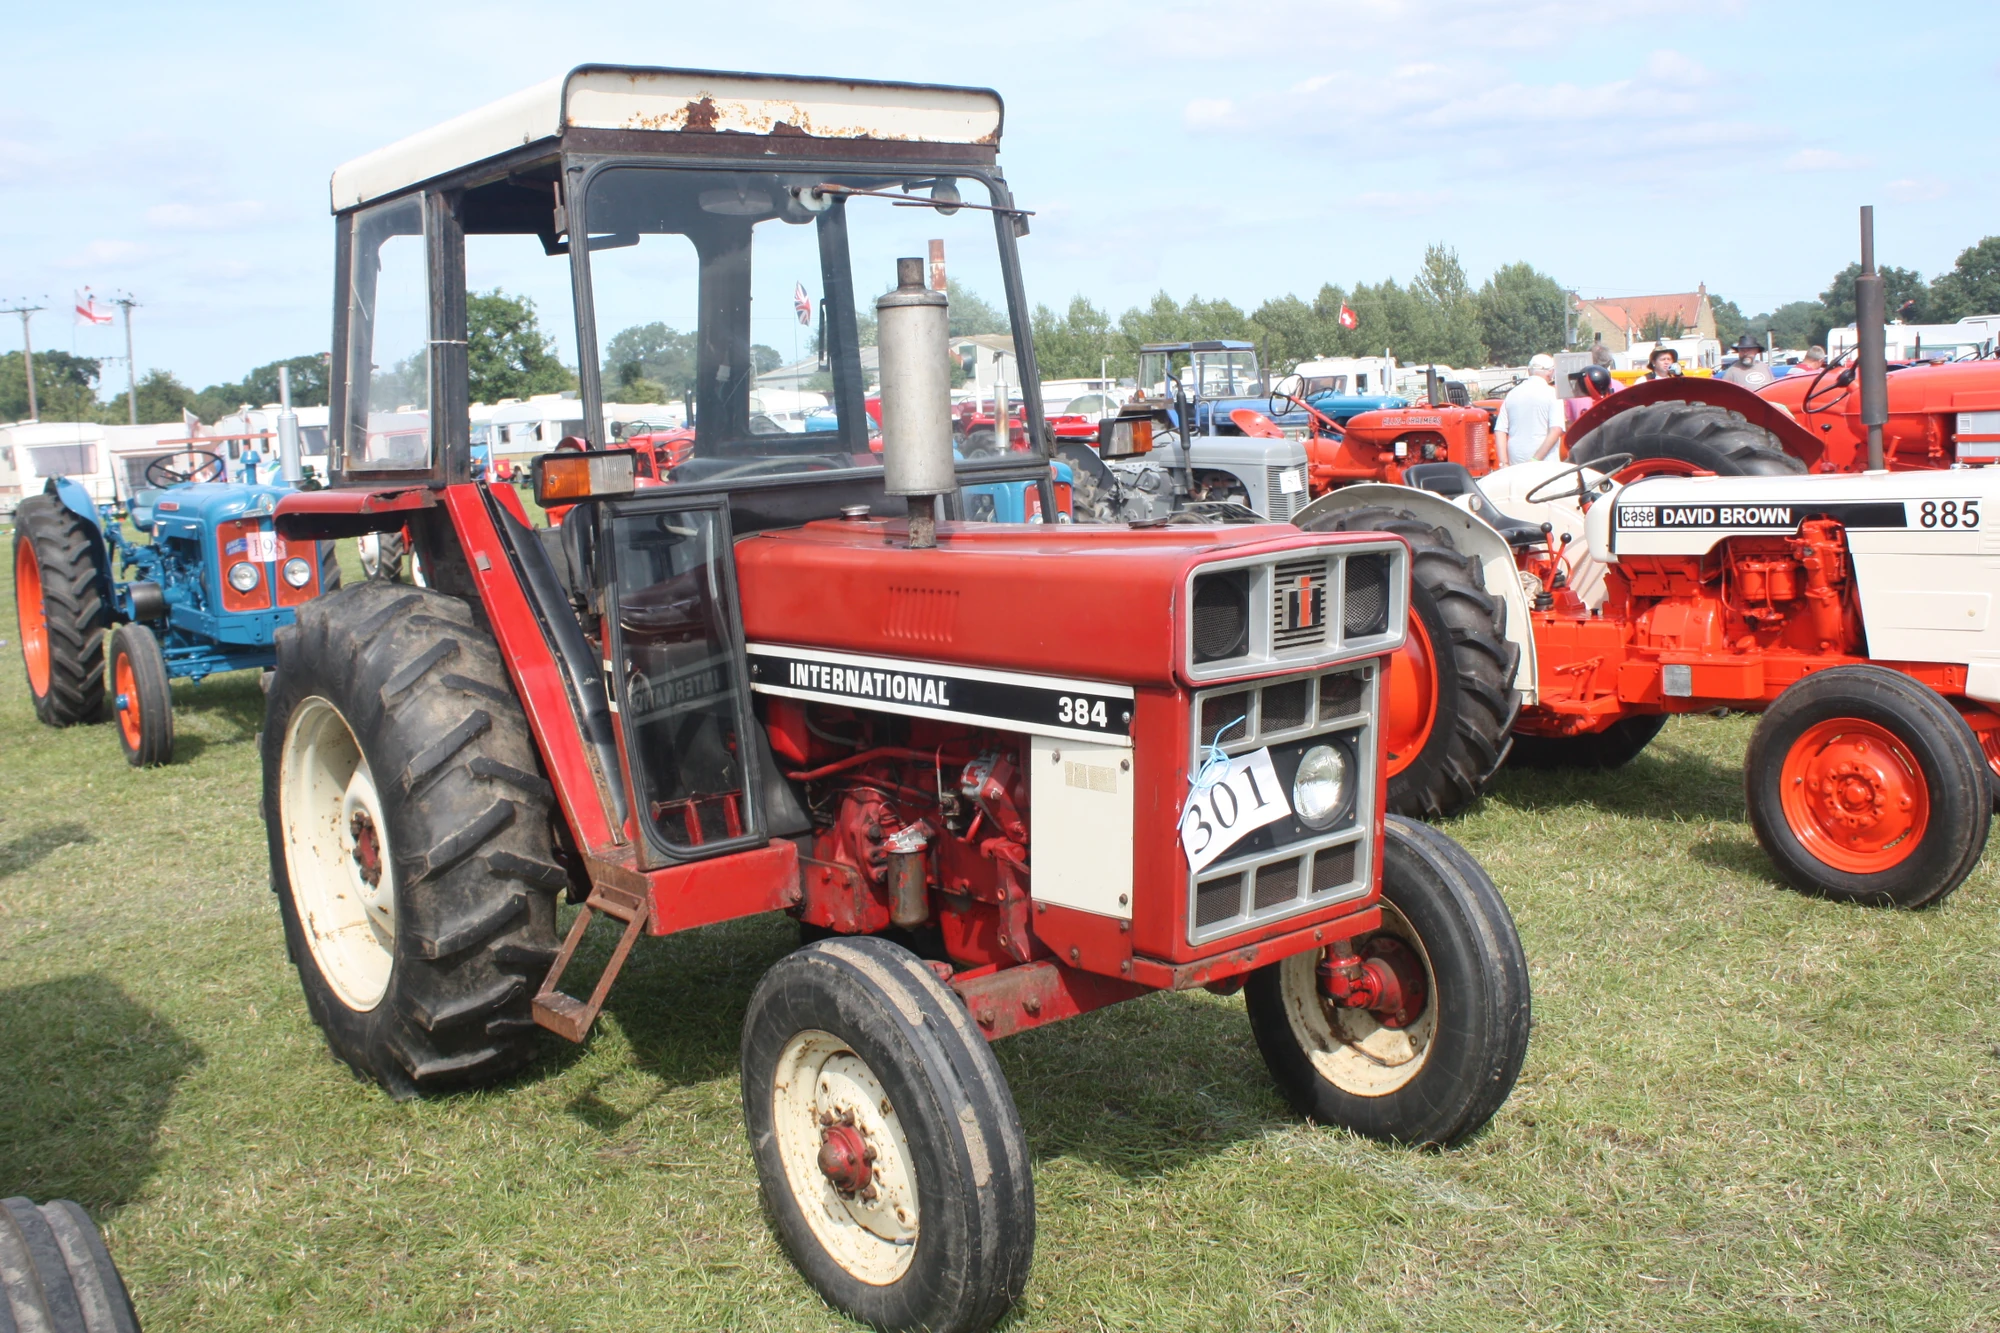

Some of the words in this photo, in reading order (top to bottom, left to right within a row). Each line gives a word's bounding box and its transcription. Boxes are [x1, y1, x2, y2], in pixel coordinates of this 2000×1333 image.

[1622, 509, 1655, 524] case
[1663, 508, 1715, 525] DAVID
[1720, 507, 1791, 524] BROWN
[1920, 500, 1980, 528] 885
[789, 662, 950, 706] INTERNATIONAL
[1058, 696, 1108, 728] 384
[1186, 765, 1270, 855] 301
